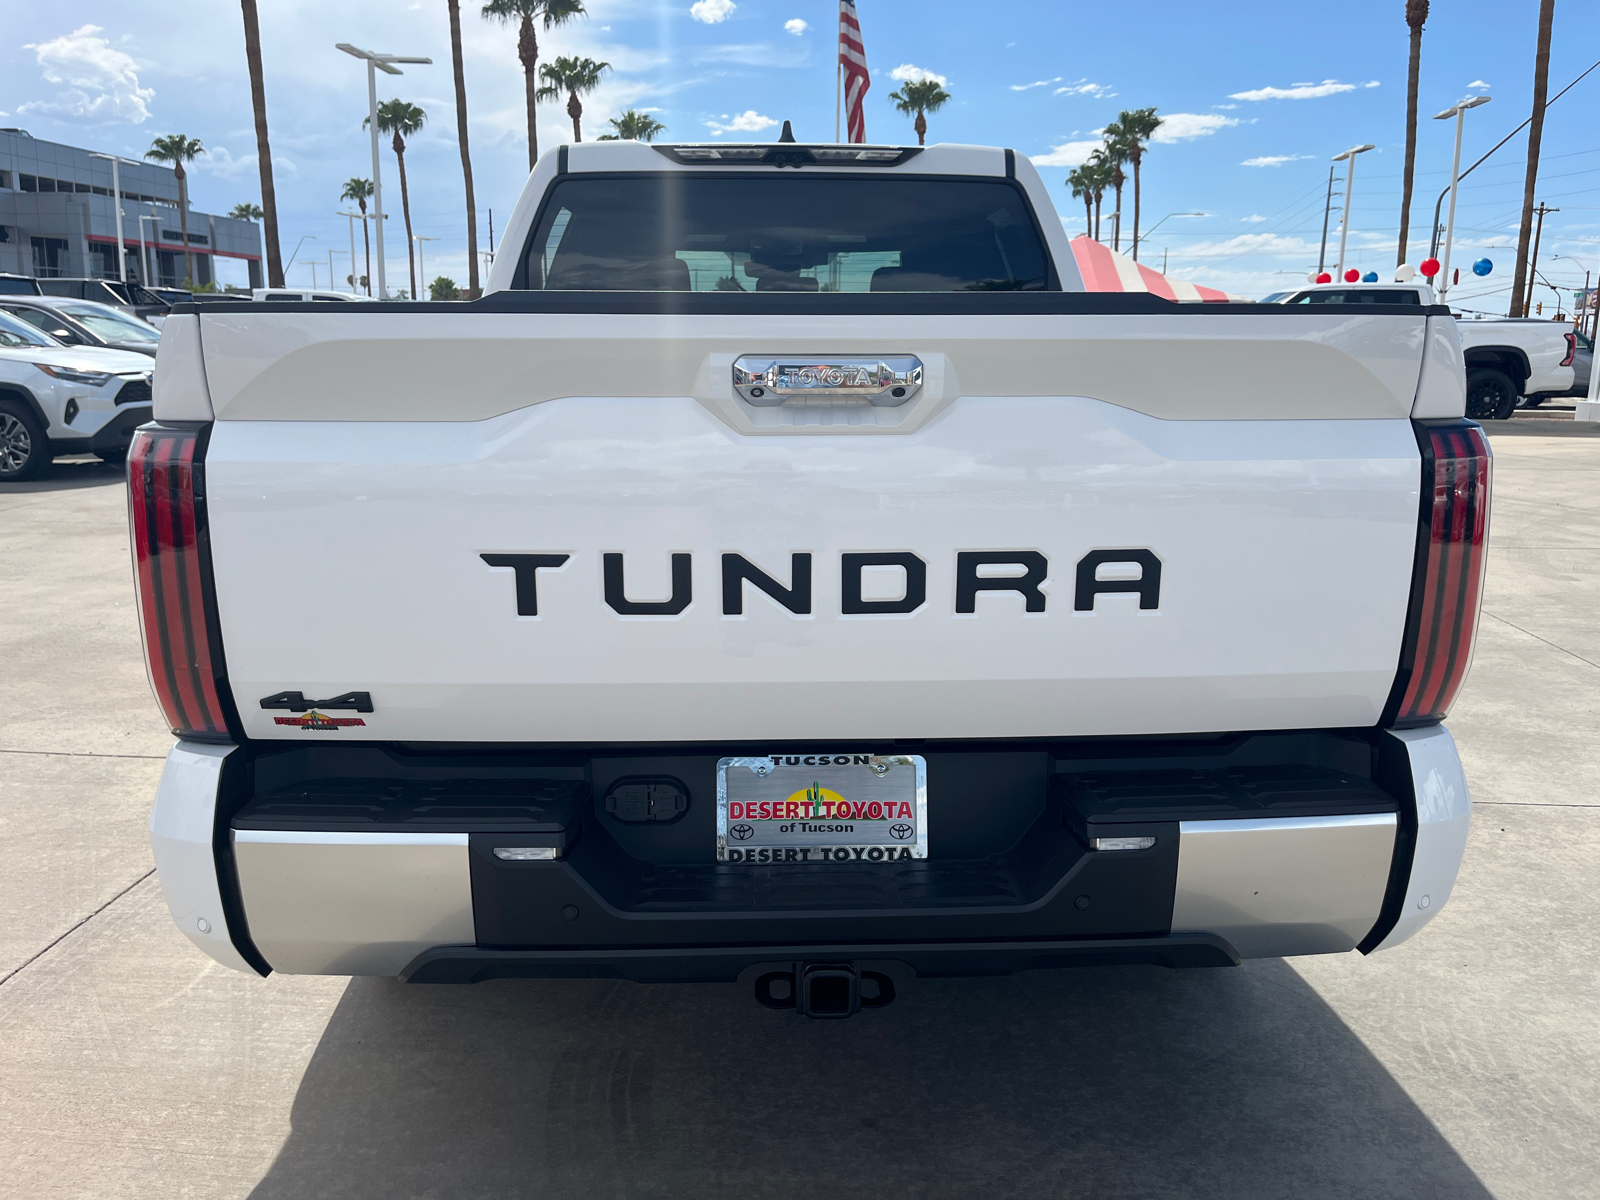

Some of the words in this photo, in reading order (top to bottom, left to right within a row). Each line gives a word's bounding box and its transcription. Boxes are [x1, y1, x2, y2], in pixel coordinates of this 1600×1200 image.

[785, 366, 872, 387] TOYOTA
[479, 548, 1163, 617] TUNDRA
[274, 717, 315, 726] DESERT
[320, 718, 366, 726] TOYOTA
[771, 755, 870, 766] TUCSON
[729, 801, 814, 820] DESERT
[821, 801, 913, 819] TOYOTA
[779, 823, 796, 833] of
[798, 822, 854, 833] Tucson
[728, 848, 811, 863] DESERT
[820, 847, 914, 861] TOYOTA
